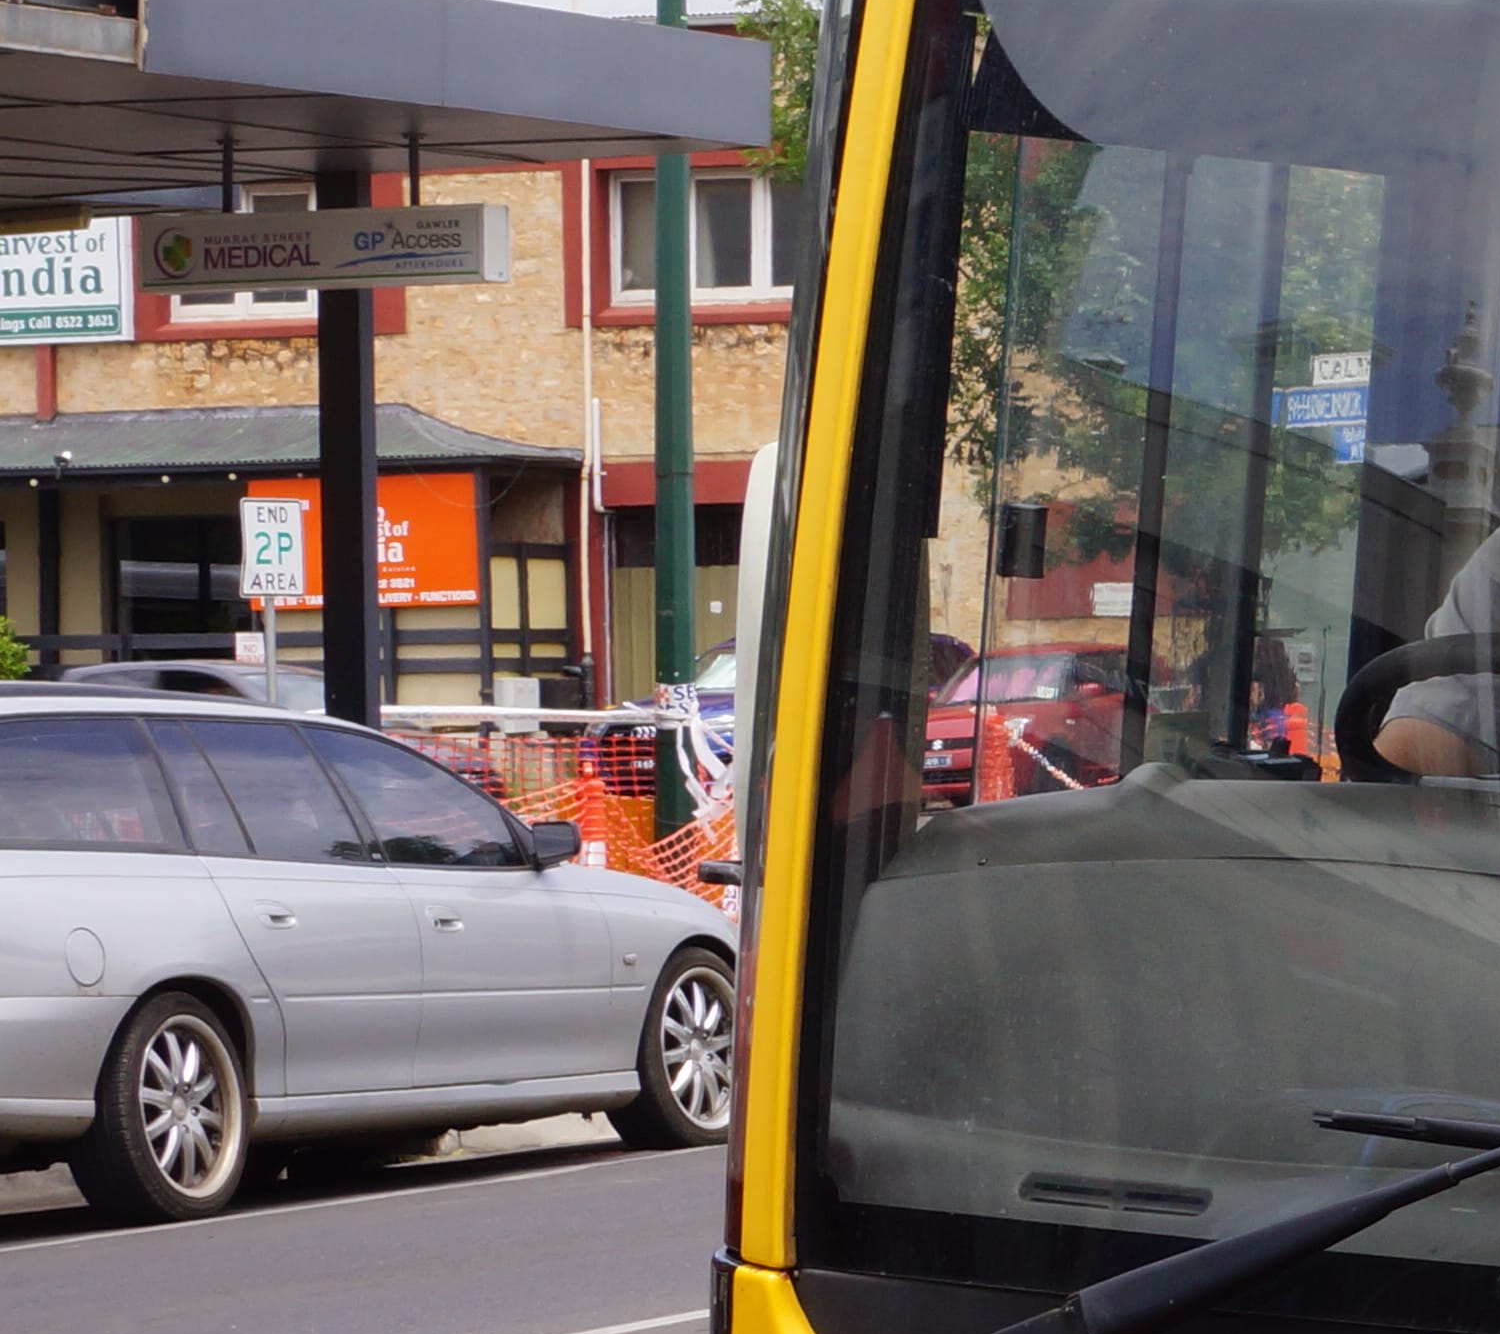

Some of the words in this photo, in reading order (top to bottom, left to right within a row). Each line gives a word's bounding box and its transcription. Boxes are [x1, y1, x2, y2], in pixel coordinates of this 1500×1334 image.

[416, 219, 461, 230] GAWLER
[85, 232, 105, 253] of
[203, 234, 259, 245] MURRAY
[263, 231, 311, 242] STREET
[353, 231, 384, 251] GP
[391, 229, 462, 250] Access
[203, 244, 321, 269] MEDICAL
[28, 315, 52, 329] Call
[55, 314, 84, 329] 8522
[87, 313, 115, 328] 3621
[256, 506, 288, 523] END
[392, 520, 409, 537] of
[255, 531, 293, 566] 2P
[250, 572, 299, 590] AREA
